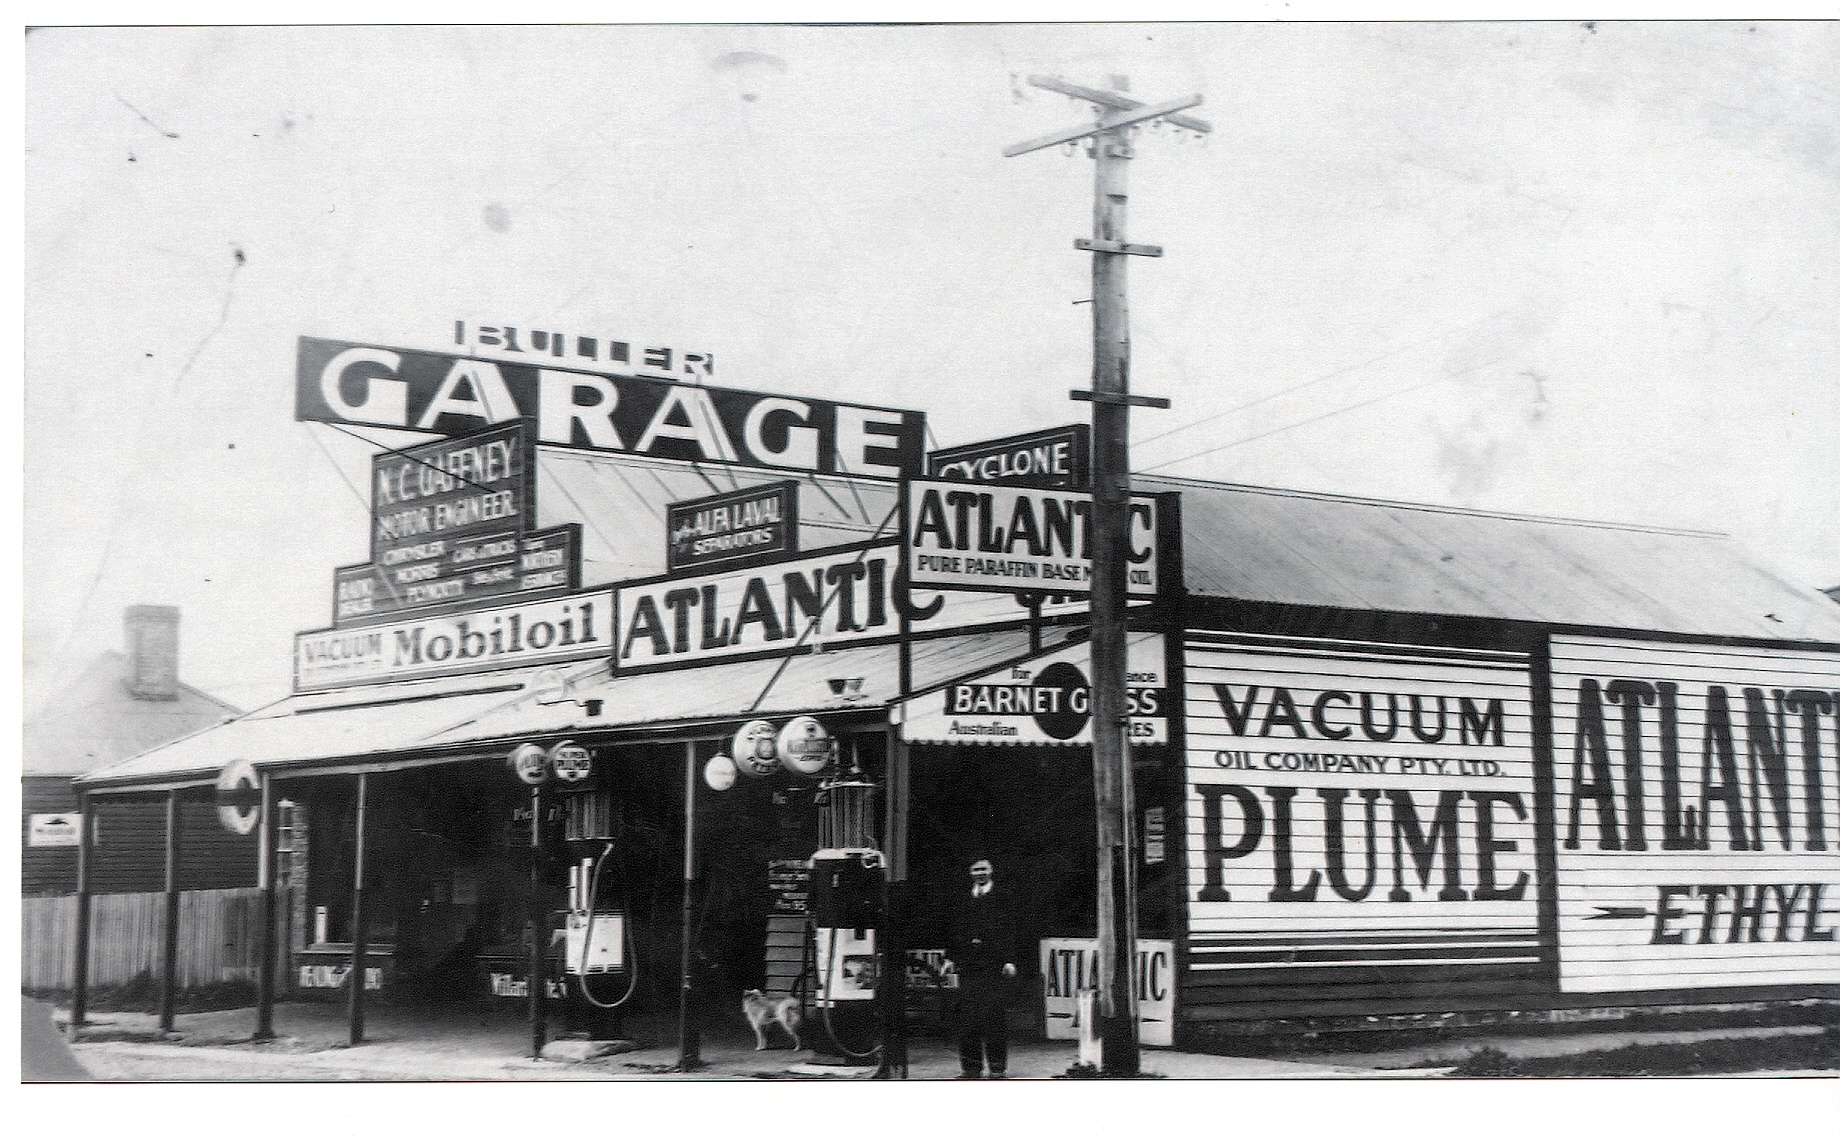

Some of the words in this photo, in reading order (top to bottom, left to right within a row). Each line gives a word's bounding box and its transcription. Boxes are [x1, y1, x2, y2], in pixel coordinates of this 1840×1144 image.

[319, 347, 902, 478] GARAGE
[732, 496, 783, 529] LAVAL
[912, 488, 1152, 564] ATLANTC
[917, 555, 962, 574] PURE
[964, 557, 1038, 578] PARAFFIN
[1041, 562, 1079, 581] BASE
[1130, 570, 1152, 585] OIL
[304, 633, 382, 664] VACUUM
[392, 602, 599, 667] Mobiloil
[948, 719, 1018, 737] Australian
[953, 685, 1062, 714] BARNET
[1069, 687, 1158, 715] GSS
[1212, 683, 1505, 747] VACUUM
[1214, 750, 1257, 770] OIL
[1263, 752, 1389, 775] COMPANY
[1400, 757, 1450, 775] PTY.
[1458, 759, 1507, 778] LTD.
[1193, 783, 1531, 903] PLUME
[1650, 883, 1838, 945] ETHYL
[1046, 949, 1167, 1002] ATLAIC
